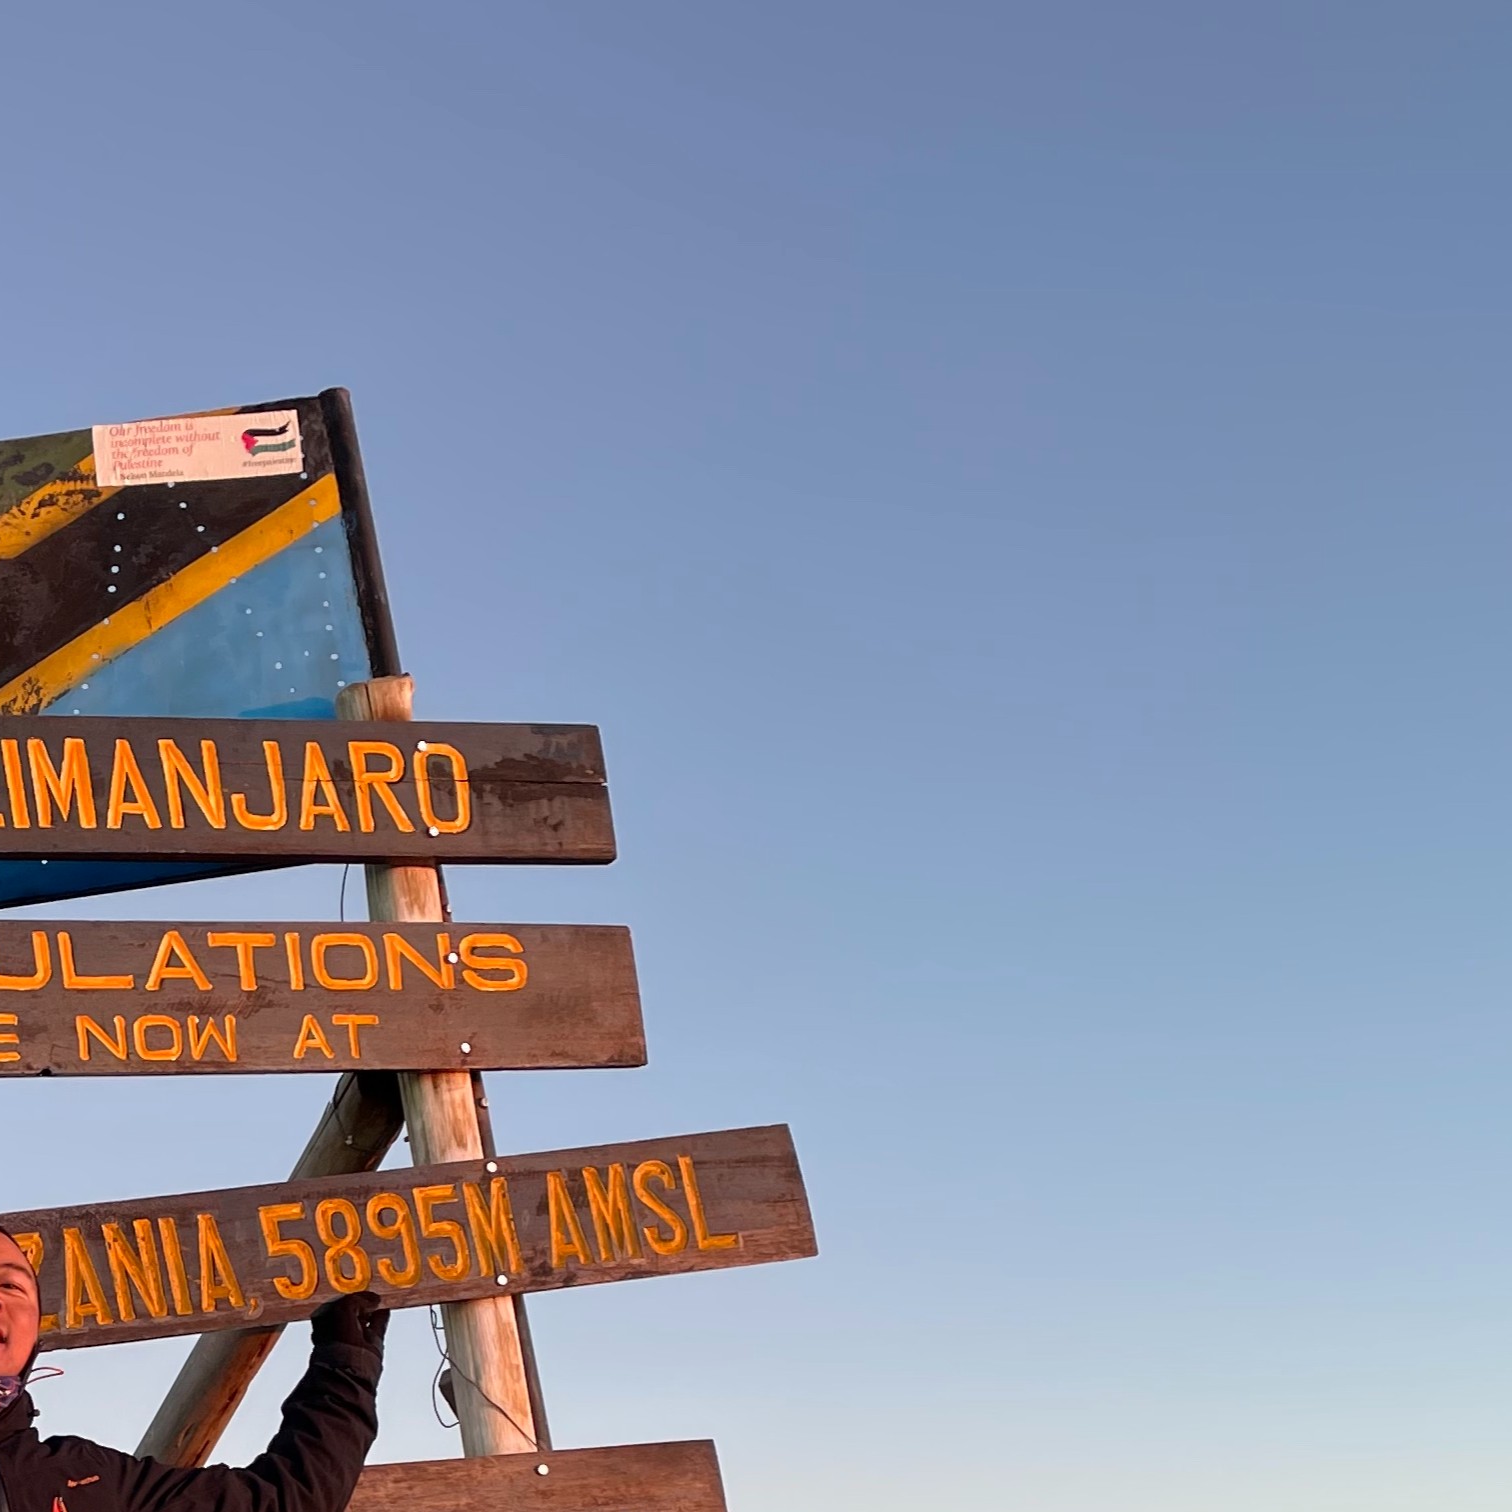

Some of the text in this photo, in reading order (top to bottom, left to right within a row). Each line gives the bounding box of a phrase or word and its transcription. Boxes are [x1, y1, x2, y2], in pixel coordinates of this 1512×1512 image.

[176, 430, 221, 443] without
[182, 444, 194, 457] of
[149, 469, 184, 478] Mandela
[75, 1013, 238, 1063] NOW
[293, 1013, 380, 1060] AT
[258, 1176, 522, 1301] 5895M
[546, 1155, 739, 1268] AMSL
